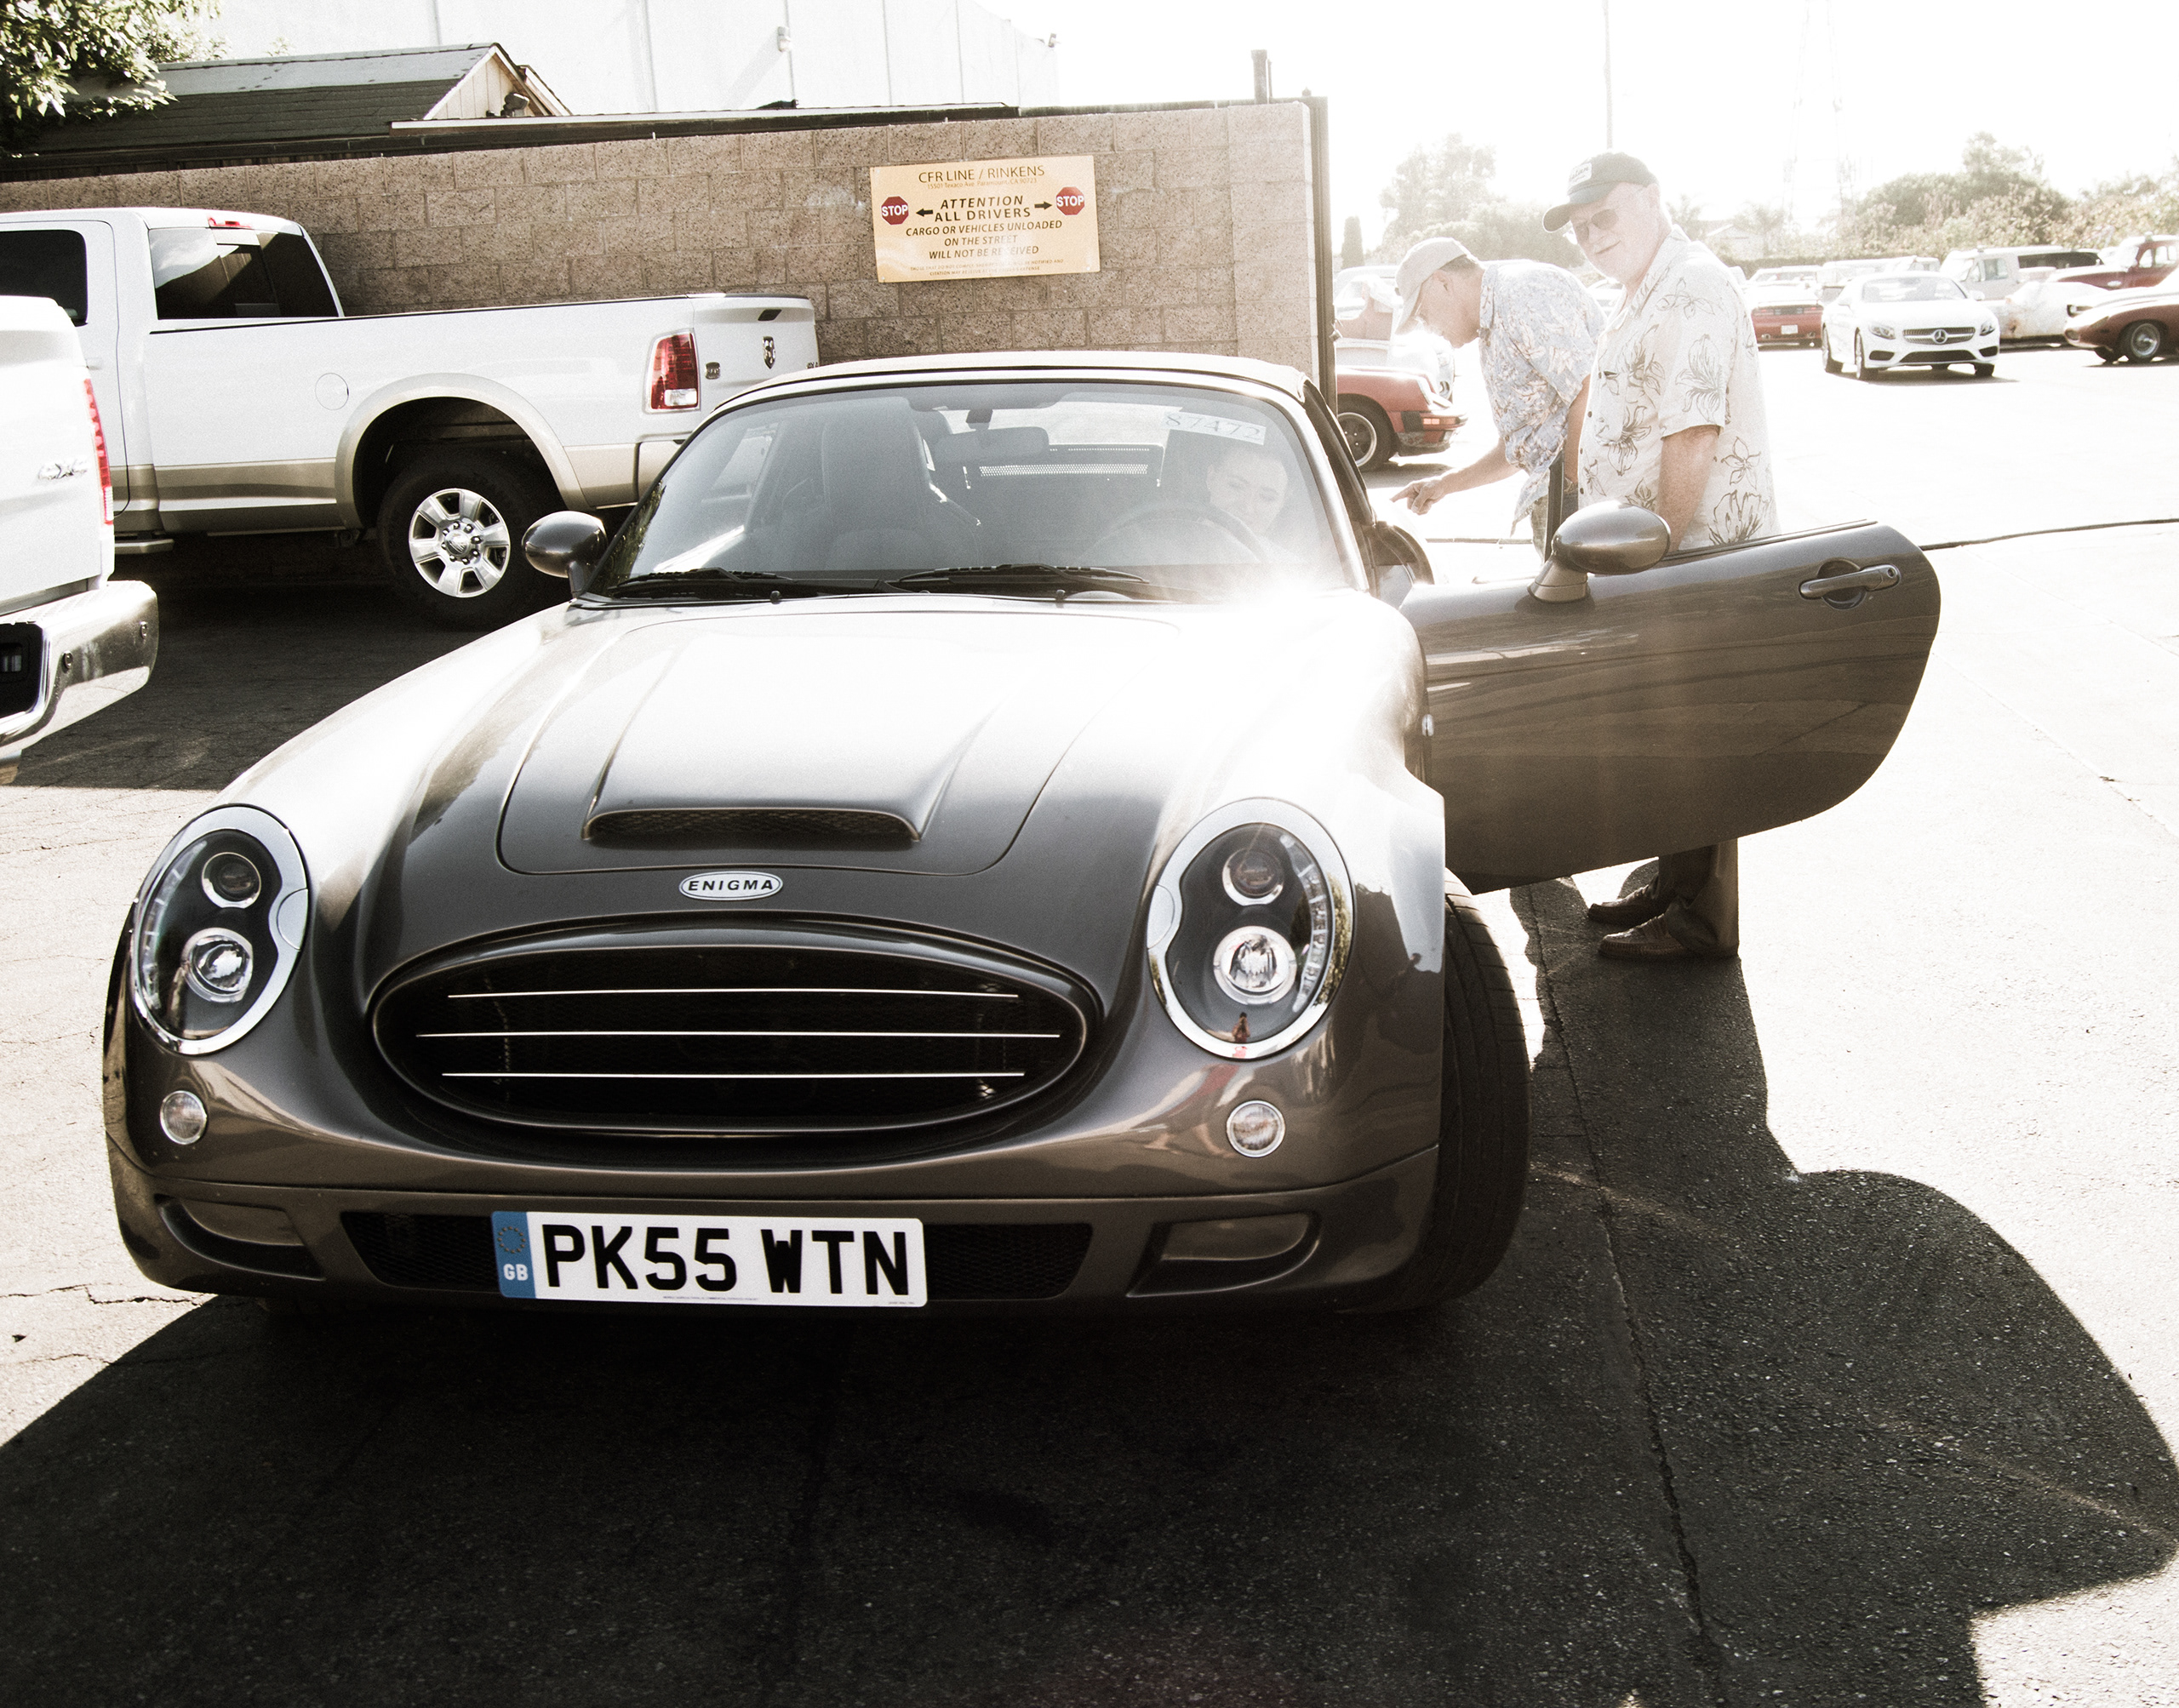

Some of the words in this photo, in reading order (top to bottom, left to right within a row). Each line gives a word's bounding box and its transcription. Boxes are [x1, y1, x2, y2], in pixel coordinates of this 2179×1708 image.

[918, 171, 943, 183] CFR
[947, 169, 975, 181] LINE
[987, 165, 1045, 179] RINKENS
[941, 195, 1023, 209] ATTENTION
[1056, 195, 1084, 207] STOP
[881, 204, 908, 217] STOP
[935, 212, 961, 222] ALL
[967, 207, 1031, 220] DRIVERS
[906, 226, 940, 237] CARGO
[942, 226, 956, 235] OR
[958, 223, 1004, 233] VEHICLES
[1007, 220, 1062, 231] UNLOADED
[944, 237, 958, 247] ON
[962, 237, 980, 245] THE
[982, 235, 1018, 245] STREET
[929, 250, 952, 259] WILL
[954, 249, 975, 258] NOT
[977, 248, 988, 257] BE
[992, 246, 1038, 256] REEIVED
[1164, 413, 1263, 441] 87472
[688, 879, 774, 891] ENIGMA
[541, 1224, 738, 1293] PK55
[760, 1228, 910, 1296] WTN
[503, 1264, 529, 1281] GB
